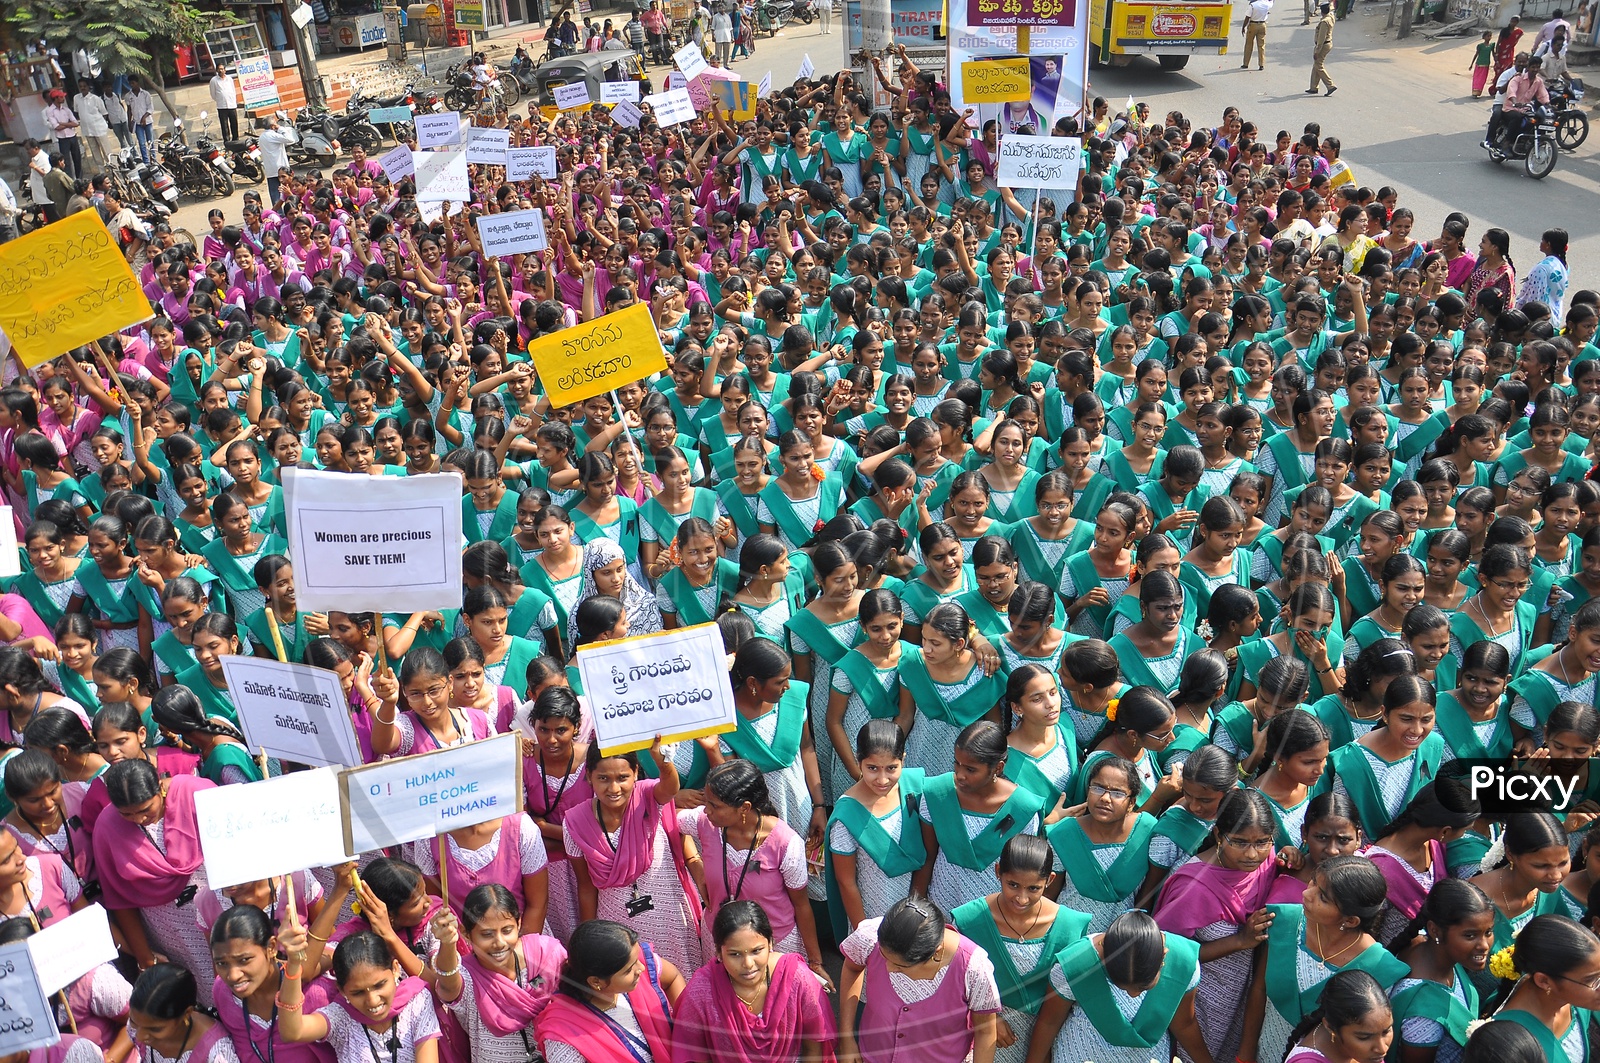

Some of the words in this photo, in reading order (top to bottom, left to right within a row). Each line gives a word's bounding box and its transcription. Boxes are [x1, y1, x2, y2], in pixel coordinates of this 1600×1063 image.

[899, 11, 943, 23] TRAFF
[893, 25, 929, 37] LICE
[314, 531, 358, 543] Women
[360, 533, 379, 543] are
[382, 529, 432, 543] precious
[344, 554, 371, 566] SAVE
[374, 552, 406, 565] THEM!
[629, 654, 692, 682] గౌరవమే
[602, 698, 655, 720] సమాజ
[658, 687, 713, 710] గౌరవం
[370, 784, 381, 796] O
[405, 767, 455, 790] HUMAN
[441, 795, 498, 819] HUMANE
